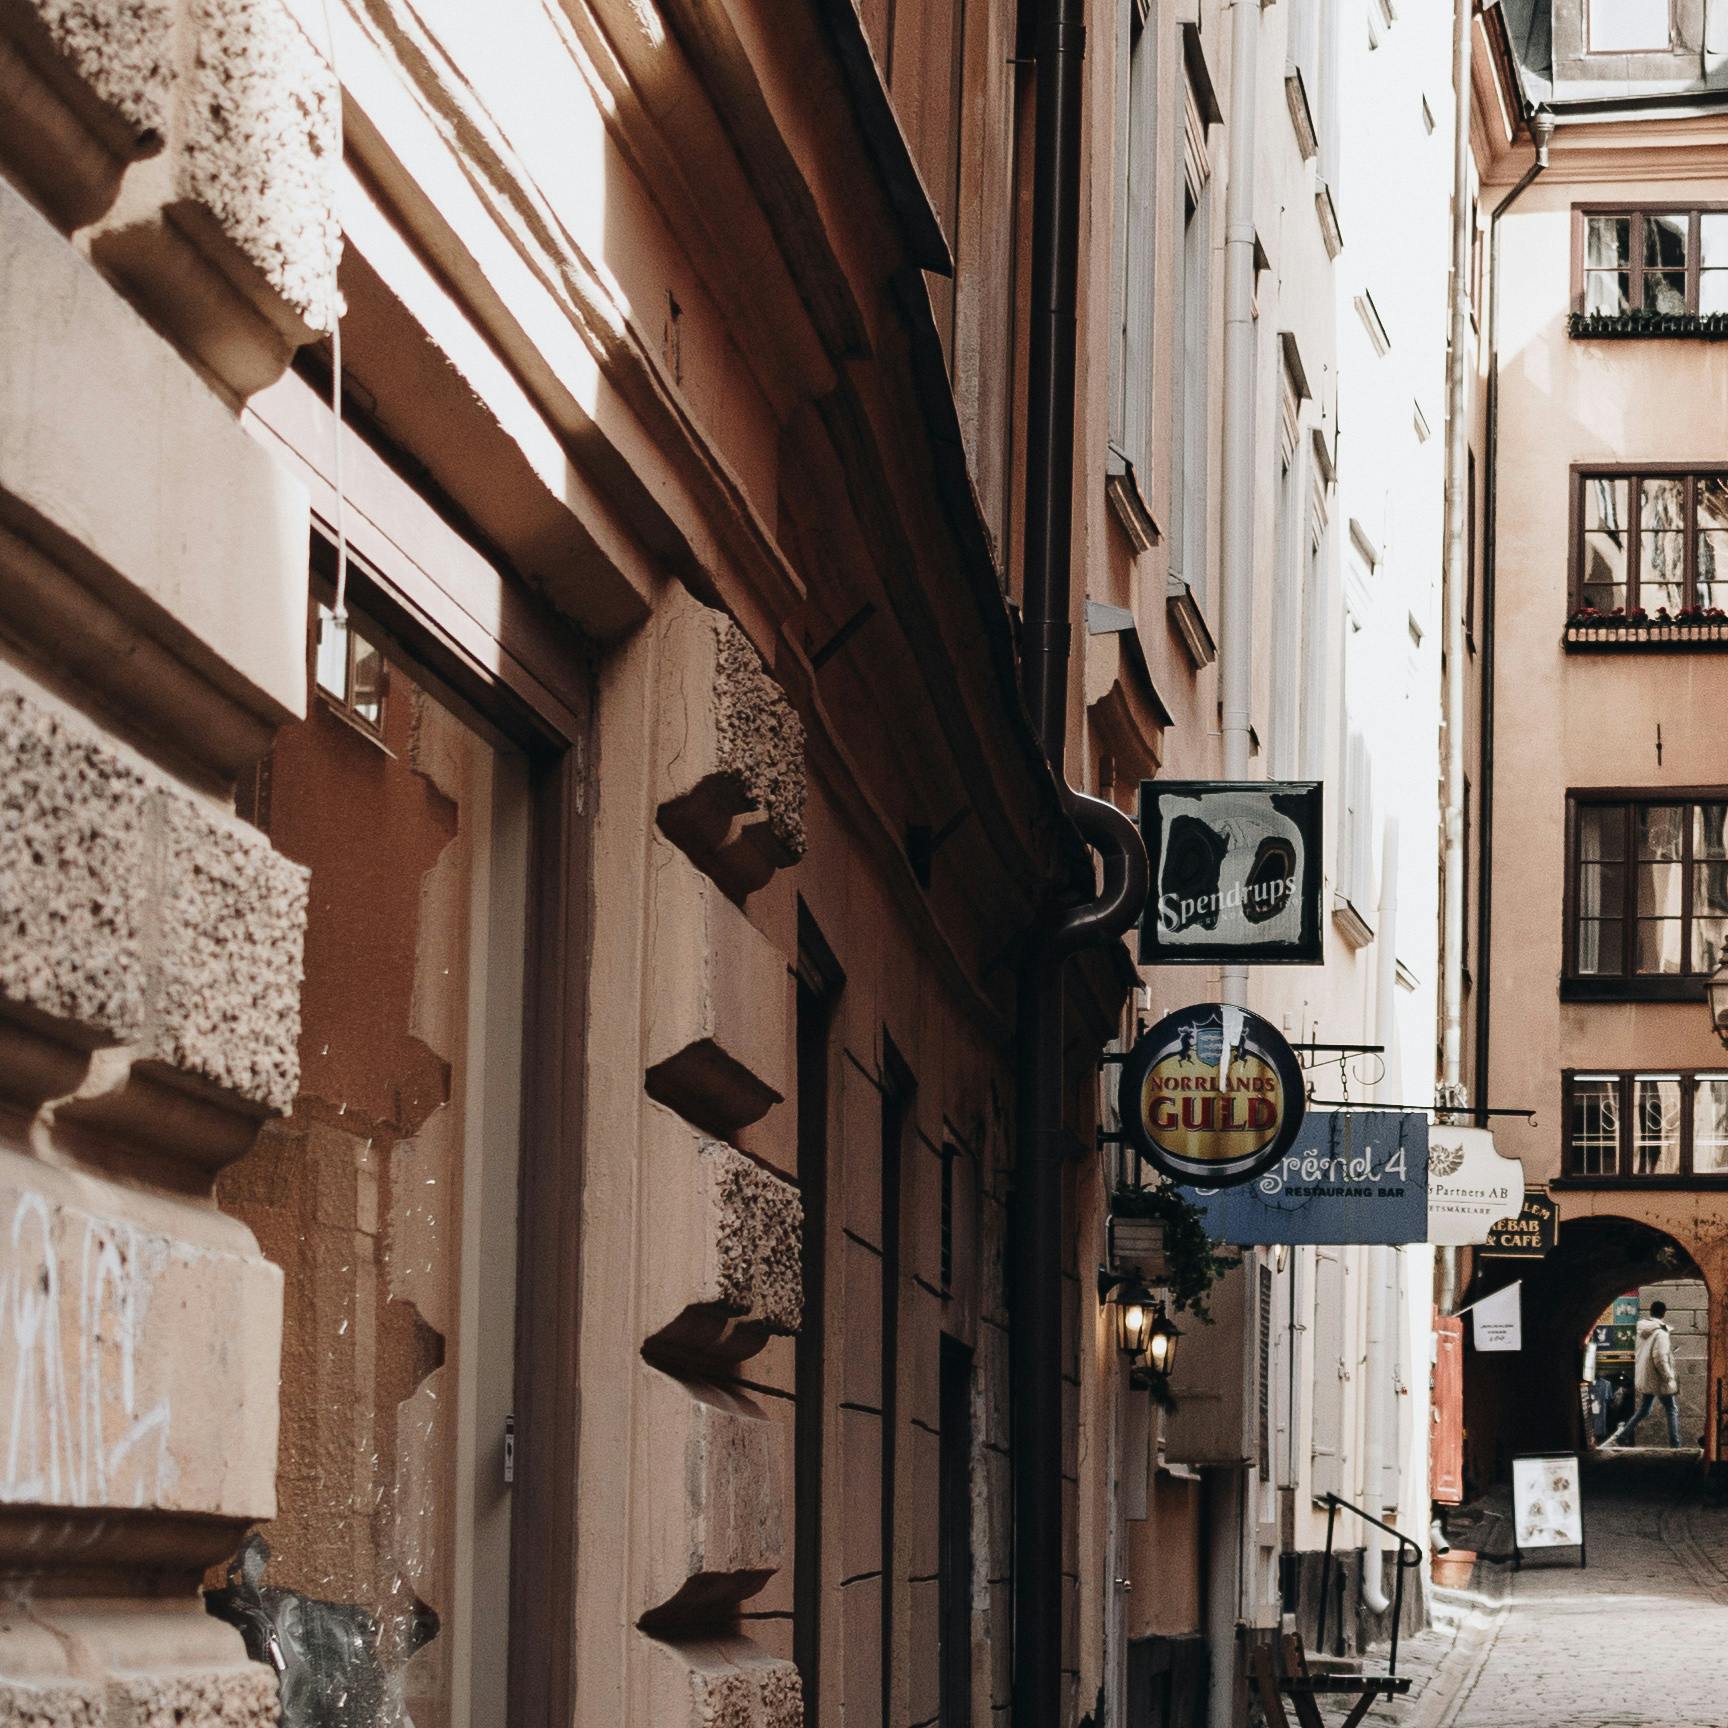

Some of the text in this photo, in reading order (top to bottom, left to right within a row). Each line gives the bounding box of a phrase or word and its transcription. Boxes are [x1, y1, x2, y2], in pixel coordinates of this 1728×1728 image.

[1158, 875, 1297, 933] Spendrups
[1150, 1076, 1276, 1092] NORRLANDS
[1149, 1095, 1278, 1132] GULD
[1384, 1146, 1408, 1182] 4
[1284, 1187, 1405, 1198] RESTAURANG BAR
[1436, 1184, 1485, 1198] Partners
[1488, 1187, 1509, 1199] AB
[1501, 1232, 1543, 1248] CAFÉ
